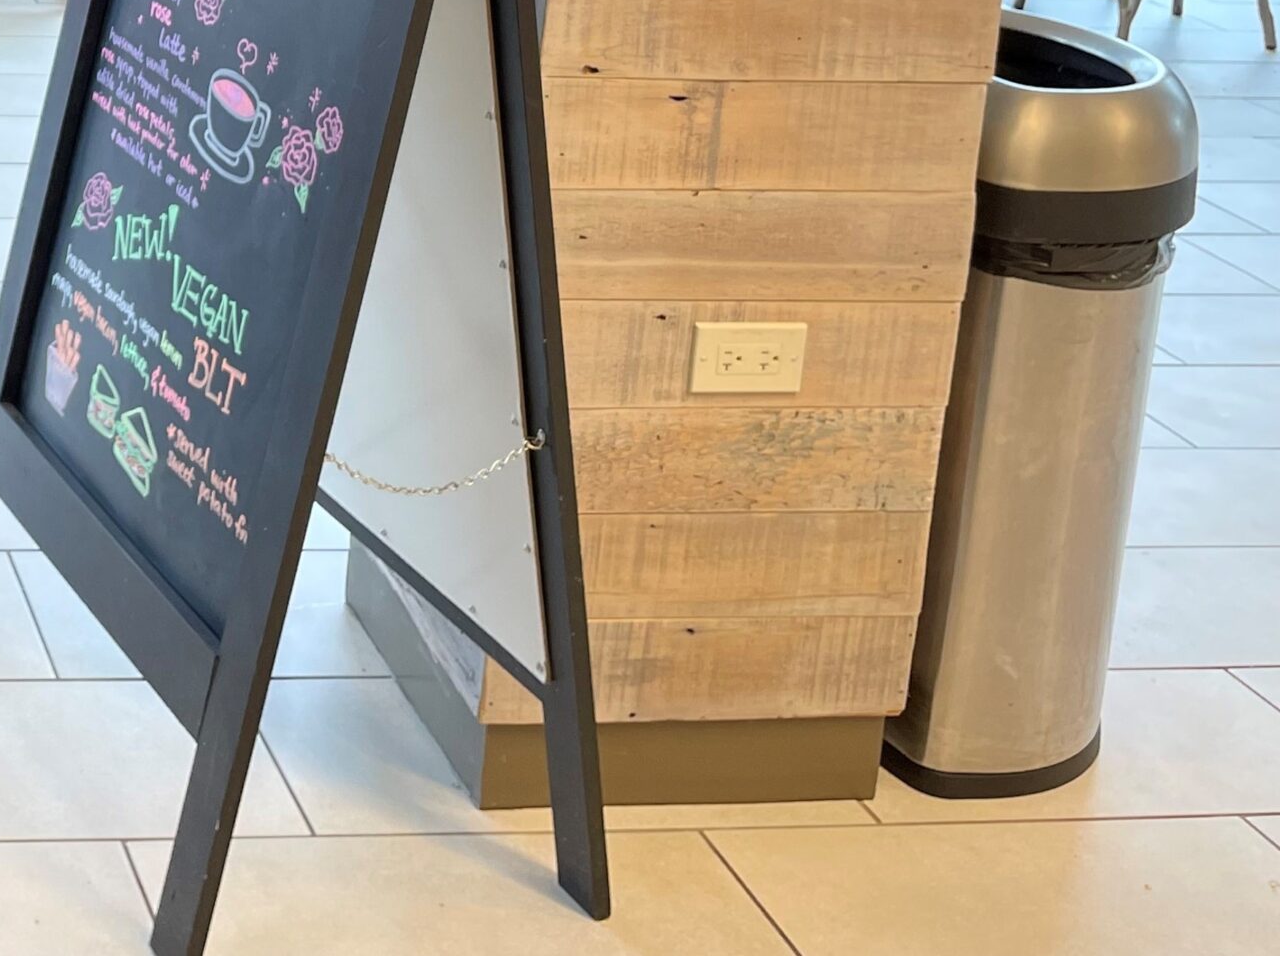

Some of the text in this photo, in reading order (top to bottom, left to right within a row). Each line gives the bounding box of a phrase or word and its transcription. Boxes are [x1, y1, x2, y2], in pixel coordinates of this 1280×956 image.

[150, 1, 172, 26] rose
[112, 204, 249, 415] NEW! VEGAN BLT
